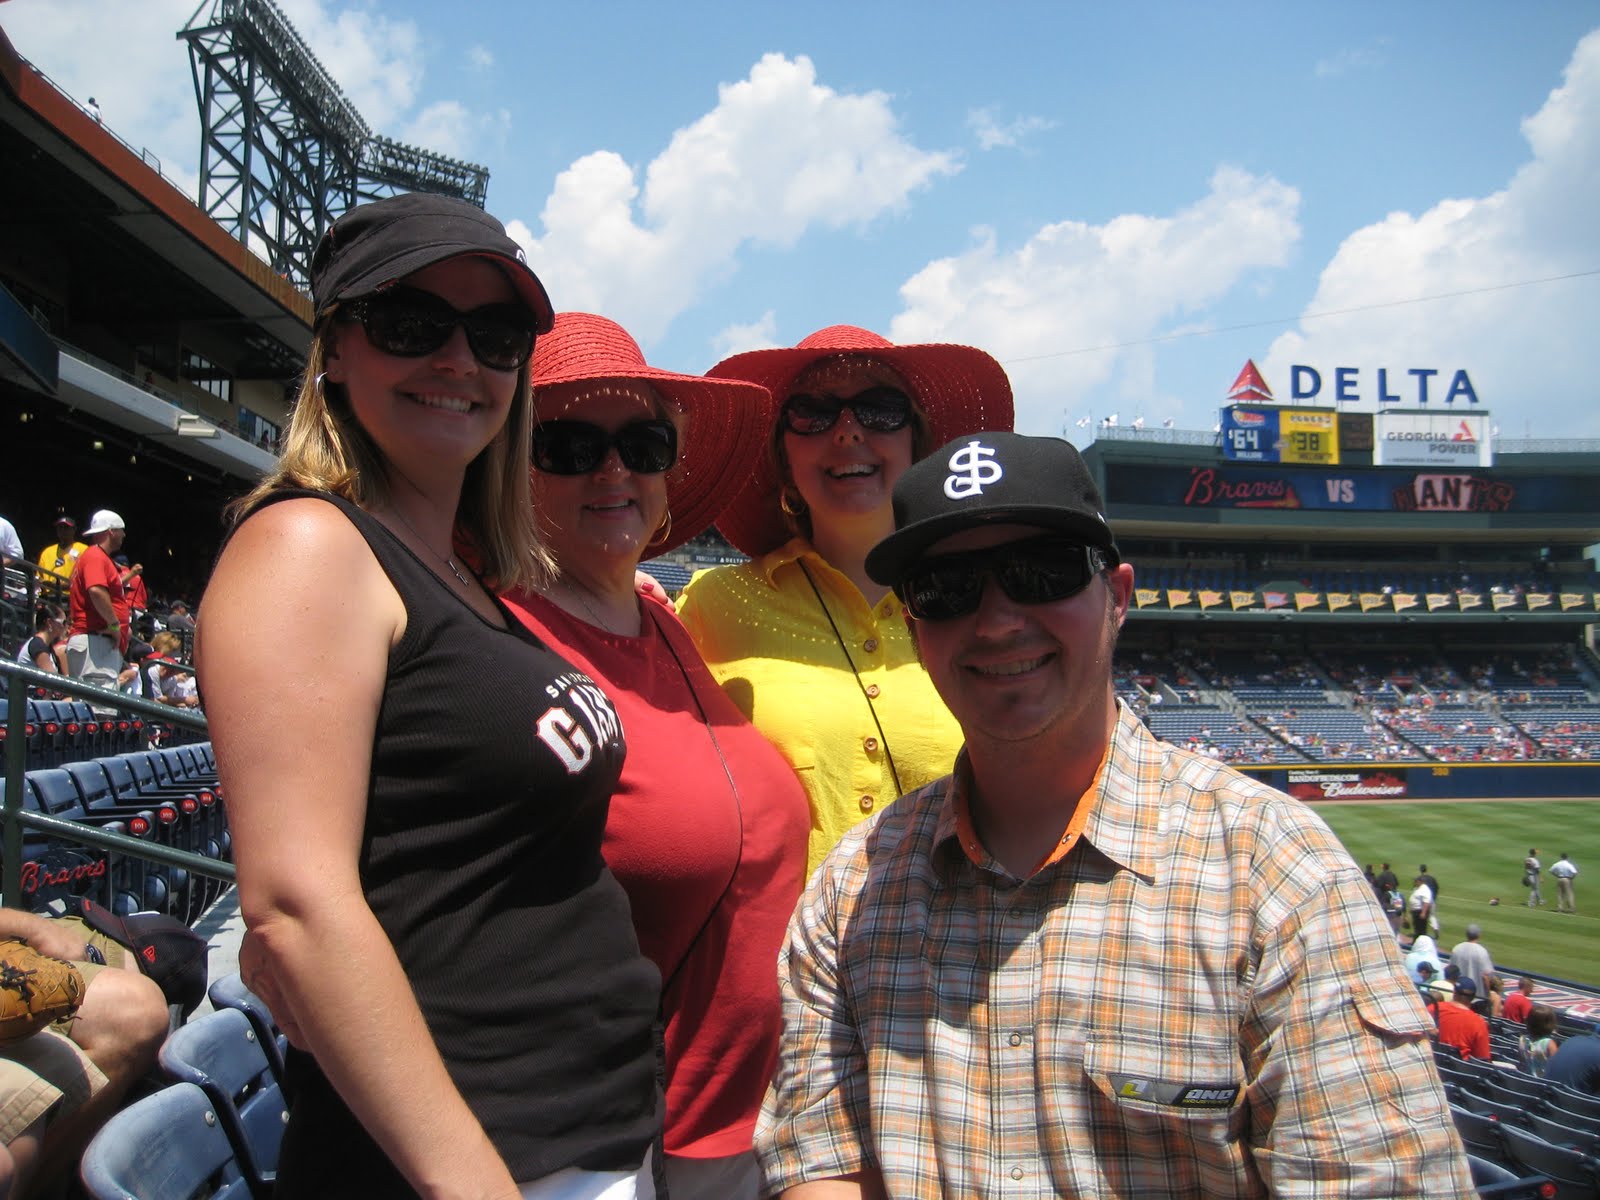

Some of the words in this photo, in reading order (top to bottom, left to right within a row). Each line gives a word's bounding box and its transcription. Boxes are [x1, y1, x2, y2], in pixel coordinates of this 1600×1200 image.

[1290, 364, 1480, 403] DELTA
[1387, 431, 1448, 442] GEORGIA
[1429, 443, 1477, 454] POWER
[1184, 467, 1285, 505] Braves
[1325, 479, 1355, 503] VS
[1320, 782, 1404, 798] Budweiser
[20, 858, 106, 894] Braves
